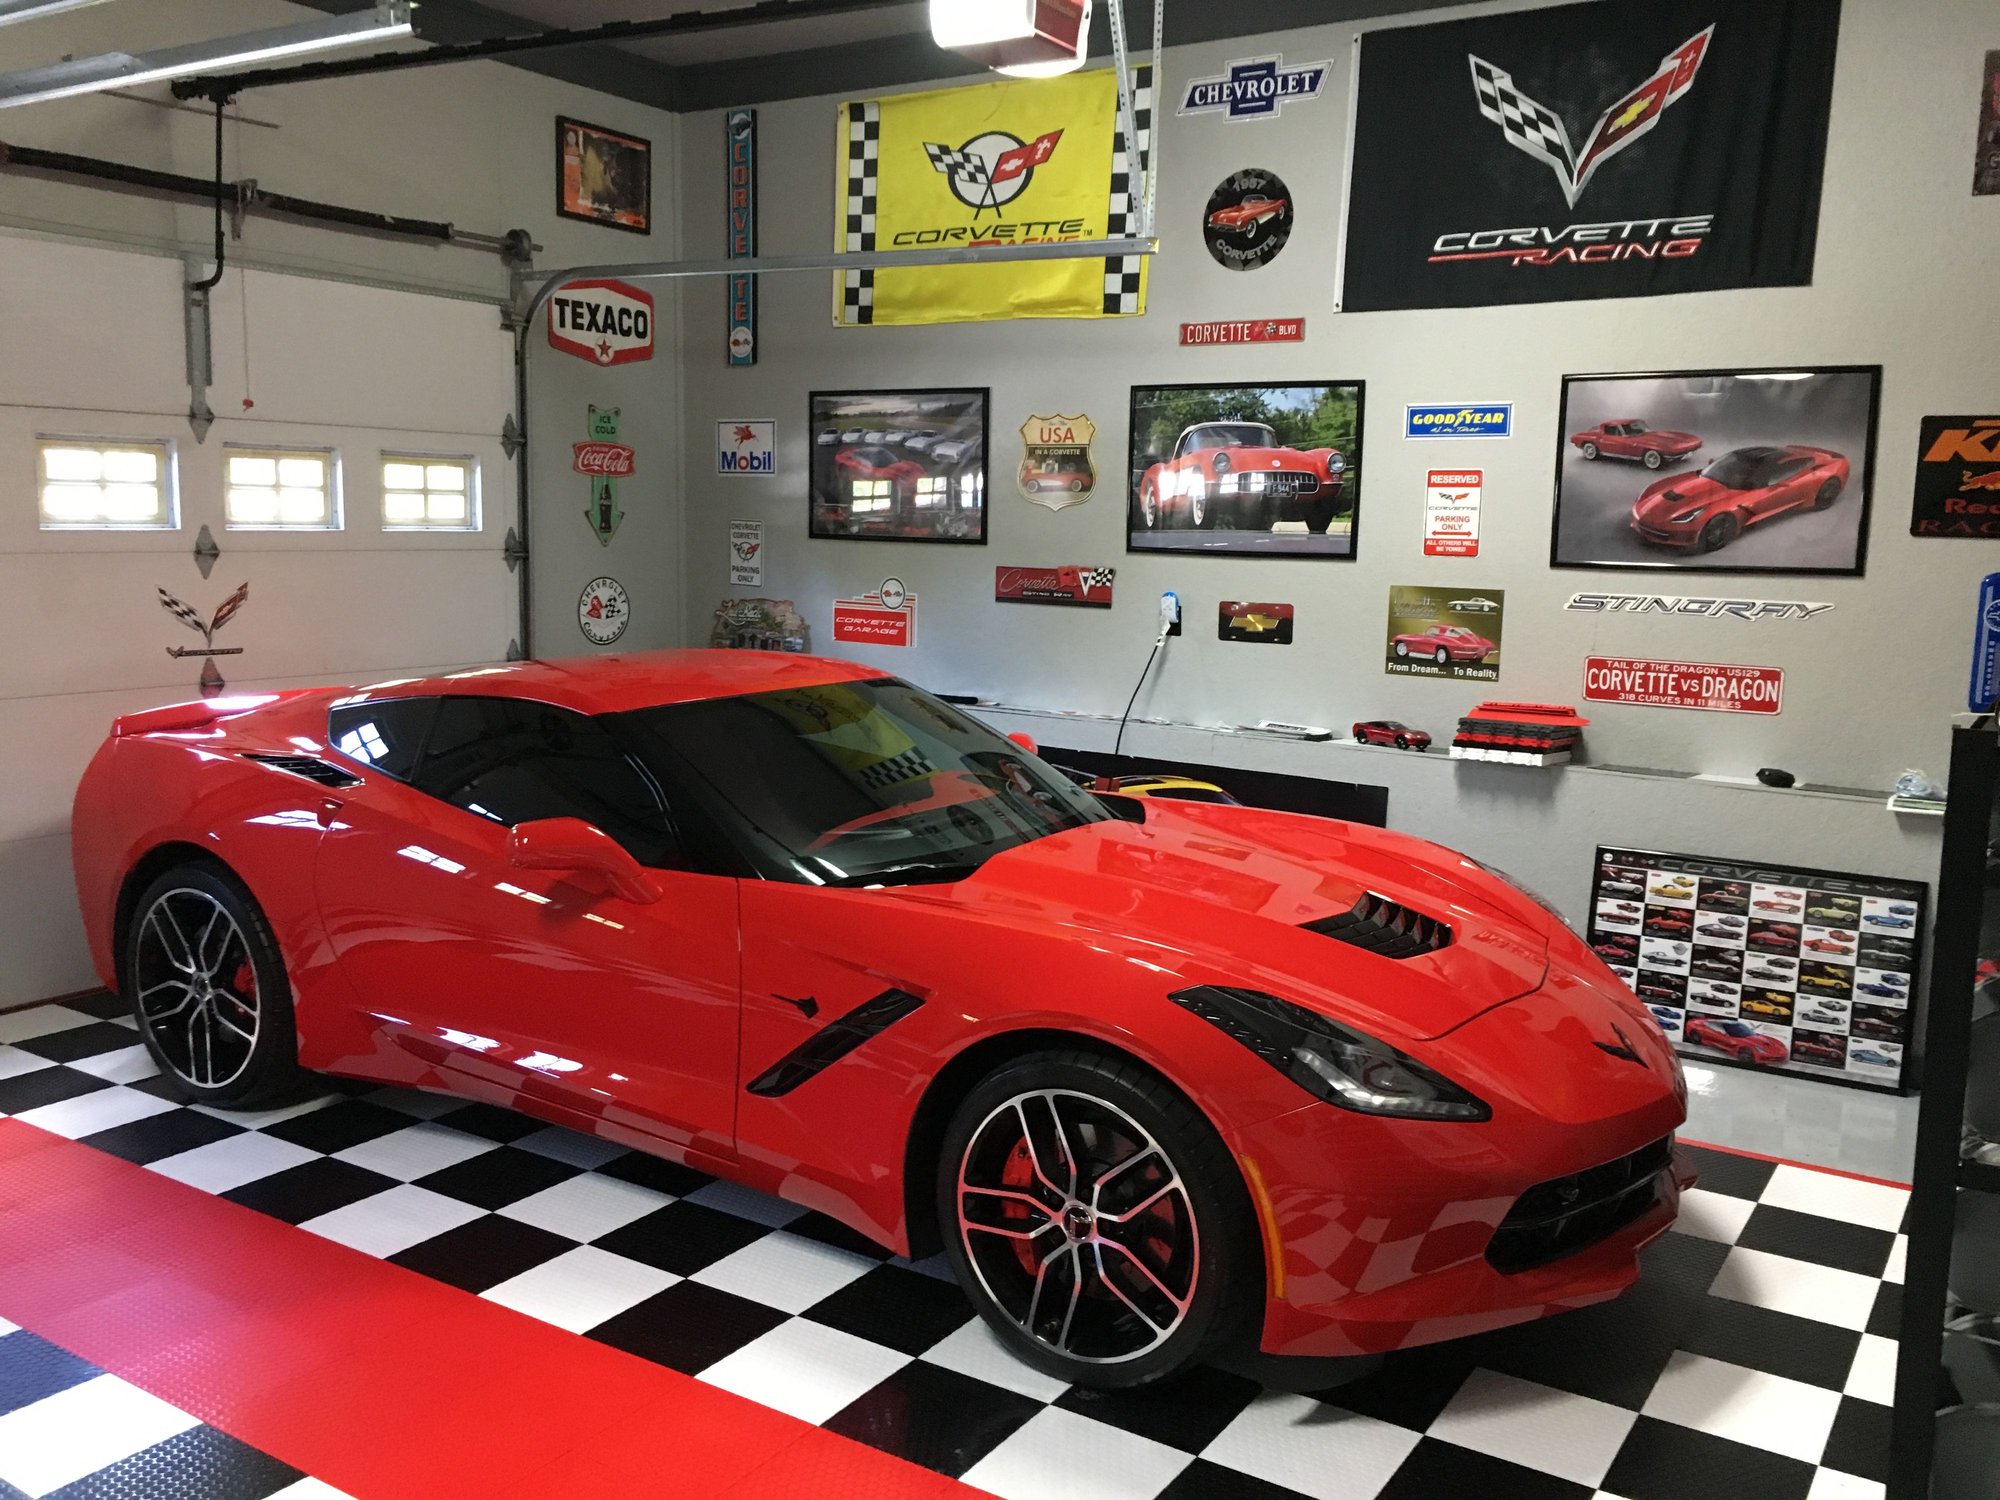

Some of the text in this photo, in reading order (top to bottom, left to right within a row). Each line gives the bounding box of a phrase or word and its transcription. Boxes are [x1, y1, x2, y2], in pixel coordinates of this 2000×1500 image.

[1194, 72, 1314, 106] CHEVROLET
[1233, 177, 1267, 192] 1957
[733, 143, 748, 321] CORVETE
[893, 218, 1085, 245] CORVETTE
[1433, 215, 1714, 252] CORVETTE
[1216, 234, 1278, 260] CORVETTE
[1512, 238, 1702, 267] RACING
[555, 297, 648, 340] TEXACO
[1187, 323, 1297, 343] CORVETTE BLVD
[595, 425, 616, 435] COLD
[1040, 427, 1075, 443] USA
[721, 451, 772, 471] Mobil
[1430, 474, 1479, 484] RESERVED
[1434, 515, 1471, 523] PARKING
[1441, 523, 1464, 531] ONLY
[731, 565, 760, 574] PARKING
[737, 574, 754, 583] ONLY
[1000, 569, 1060, 592] Corvette
[582, 580, 627, 606] CHEVROLET
[1567, 594, 1835, 621] STINGRAY
[836, 616, 906, 627] CORVETTE
[843, 625, 900, 635] GARAGE
[1388, 662, 1498, 680] From Dream... To Reality
[1606, 660, 1630, 669] TAIL
[1650, 664, 1670, 672] THE
[1673, 665, 1718, 675] DRAGON
[1726, 668, 1761, 677] US129
[1587, 668, 1779, 703] CORVETTE VS DRAGON
[1618, 692, 1636, 701] 318
[1638, 694, 1681, 705] CURVES
[1683, 697, 1694, 706] IN
[1707, 699, 1742, 709] MILES
[1658, 858, 1853, 891] CORVETTE
